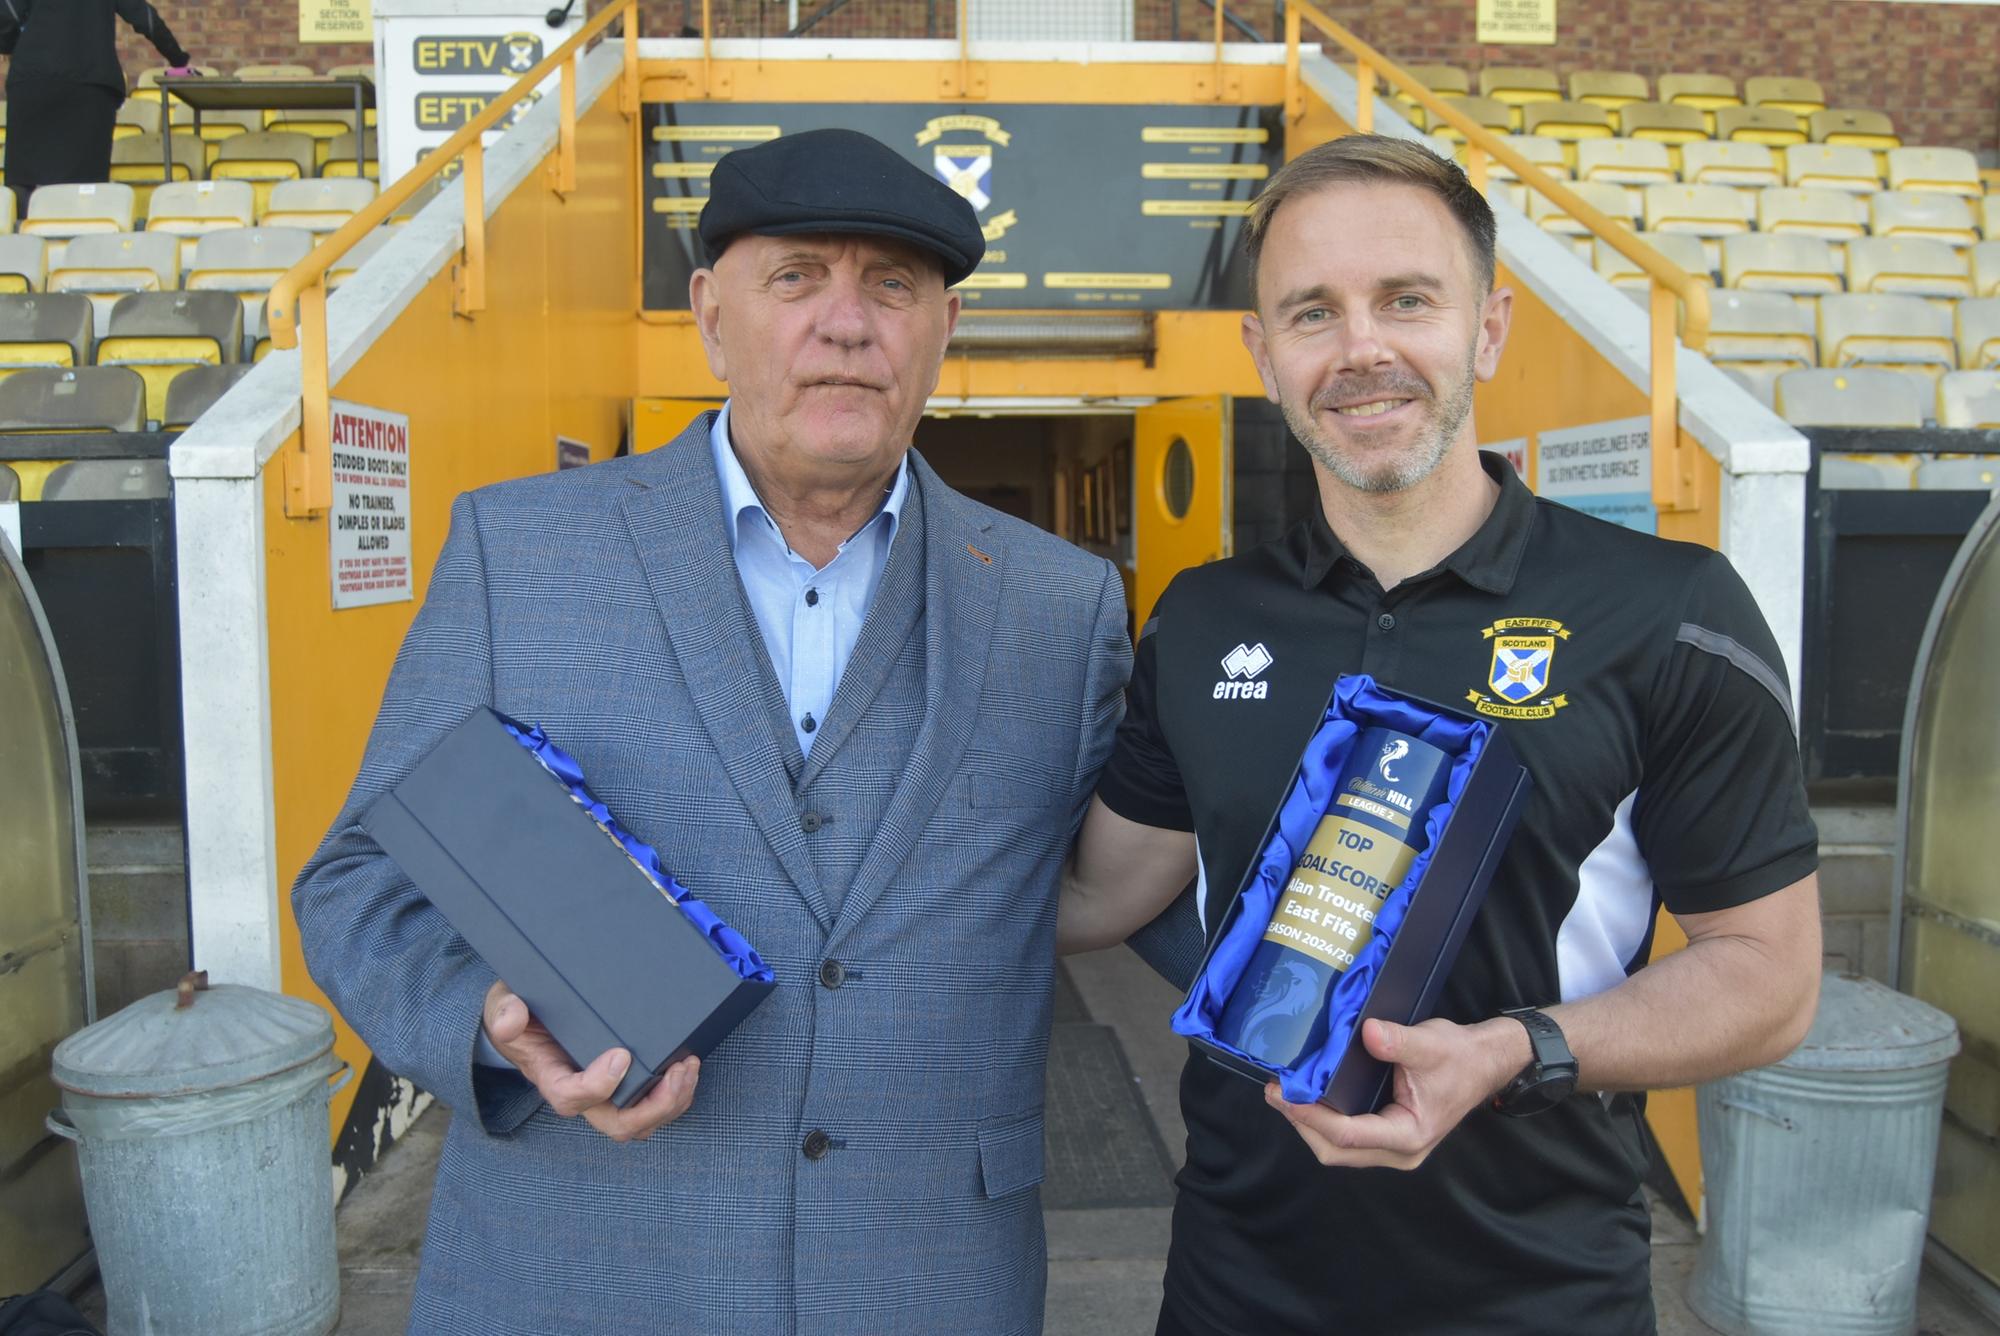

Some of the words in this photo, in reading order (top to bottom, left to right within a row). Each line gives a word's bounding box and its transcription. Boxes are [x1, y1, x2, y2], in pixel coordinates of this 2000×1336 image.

[417, 41, 498, 68] EFTV
[420, 97, 488, 124] EFT
[333, 413, 406, 454] ATTENTION
[1631, 431, 1650, 449] FOR
[333, 453, 365, 471] STUDDED
[368, 457, 389, 473] BOOTS
[391, 461, 407, 475] ONLY
[1600, 459, 1640, 479] SURFACE
[349, 494, 360, 509] NO
[338, 515, 369, 530] DIMPLES
[371, 515, 380, 530] OR
[382, 516, 405, 530] BLADES
[358, 535, 389, 550] ALLOWED
[1505, 619, 1529, 628] EAST
[1531, 619, 1553, 628] FIFE
[1502, 640, 1547, 648] SCOTLAND
[1212, 680, 1268, 700] errea
[1480, 702, 1526, 717] FOOTBALL
[1526, 707, 1551, 718] CLUB
[1348, 797, 1387, 817] LEAGUE
[1387, 811, 1395, 820] 2
[1386, 789, 1413, 811] HILL
[1336, 828, 1374, 853] TOP
[1286, 878, 1314, 896] Alan
[1317, 884, 1377, 924] Troute
[1284, 899, 1321, 923] East
[1321, 912, 1358, 941] Fife
[1268, 921, 1302, 941] EASON
[1302, 932, 1355, 965] 2024/20
